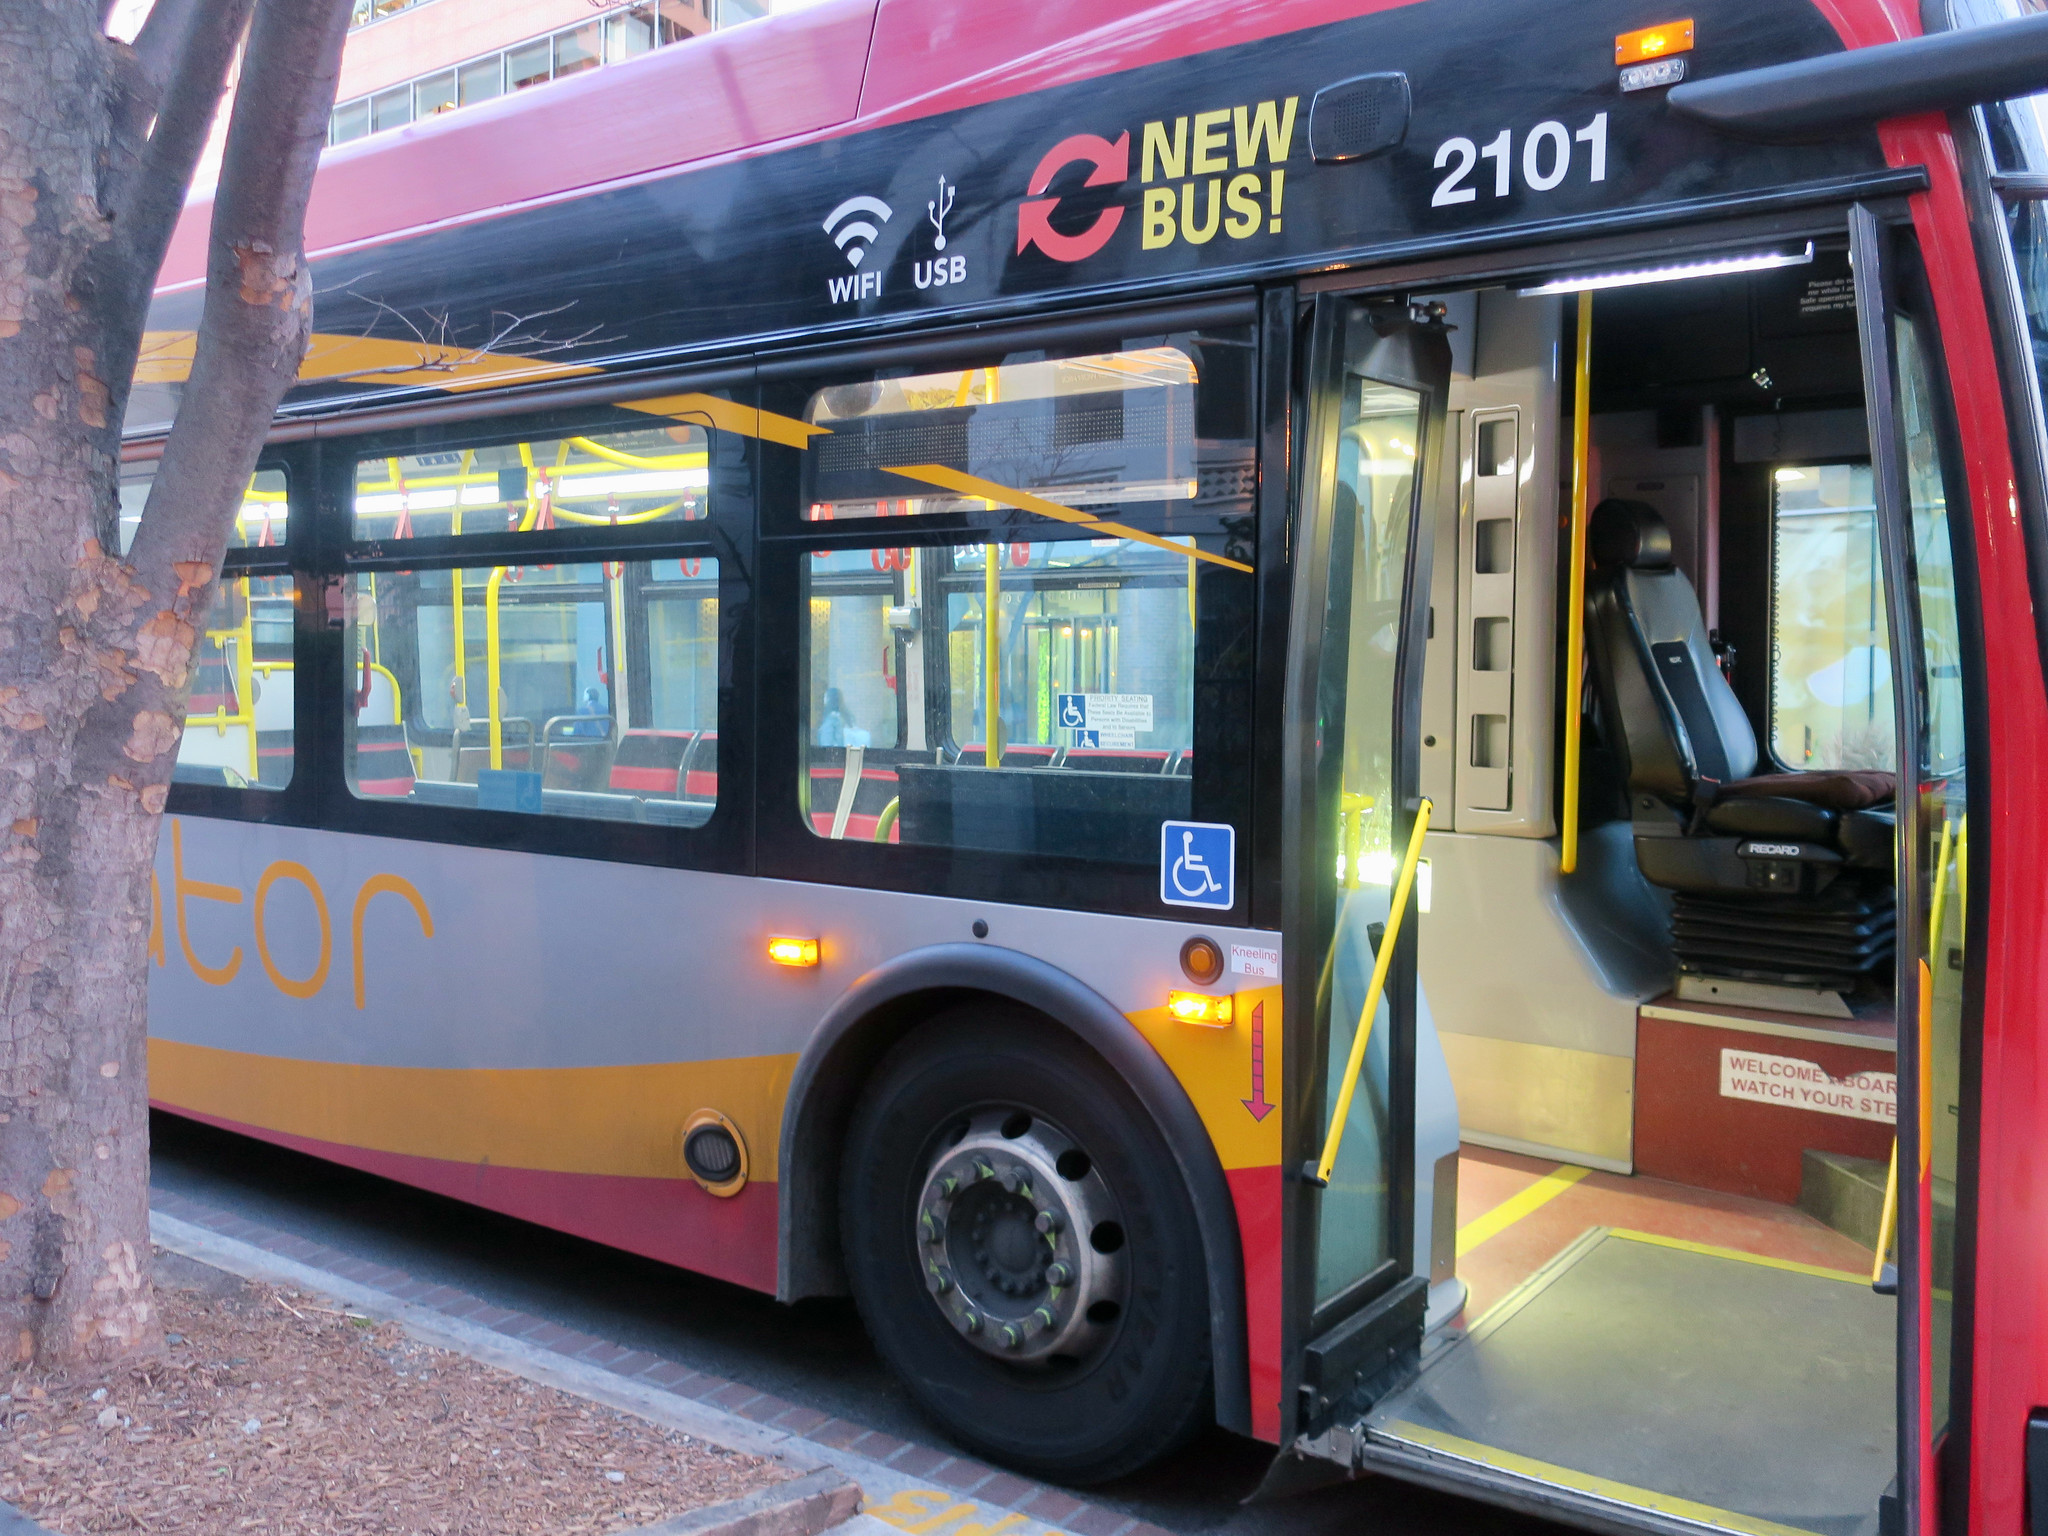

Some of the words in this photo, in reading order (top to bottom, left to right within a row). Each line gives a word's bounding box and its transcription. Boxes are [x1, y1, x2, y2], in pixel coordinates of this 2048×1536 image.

[1141, 95, 1298, 184] NEW
[1431, 111, 1608, 208] 2101
[1142, 169, 1285, 251] BUS!
[828, 270, 883, 304] WIFI
[914, 255, 967, 290] USB
[1090, 695, 1118, 703] PRIORITY
[1121, 695, 1148, 703] SEATING
[1749, 843, 1800, 856] RECARO
[1231, 946, 1278, 964] Kneeling
[1244, 963, 1265, 976] Bus
[1730, 1056, 1823, 1083] WELCOME
[1829, 1075, 1897, 1095] BOAR
[1731, 1077, 1794, 1100] WATCH
[1800, 1088, 1854, 1110] YOUR
[1860, 1098, 1897, 1117] STE
